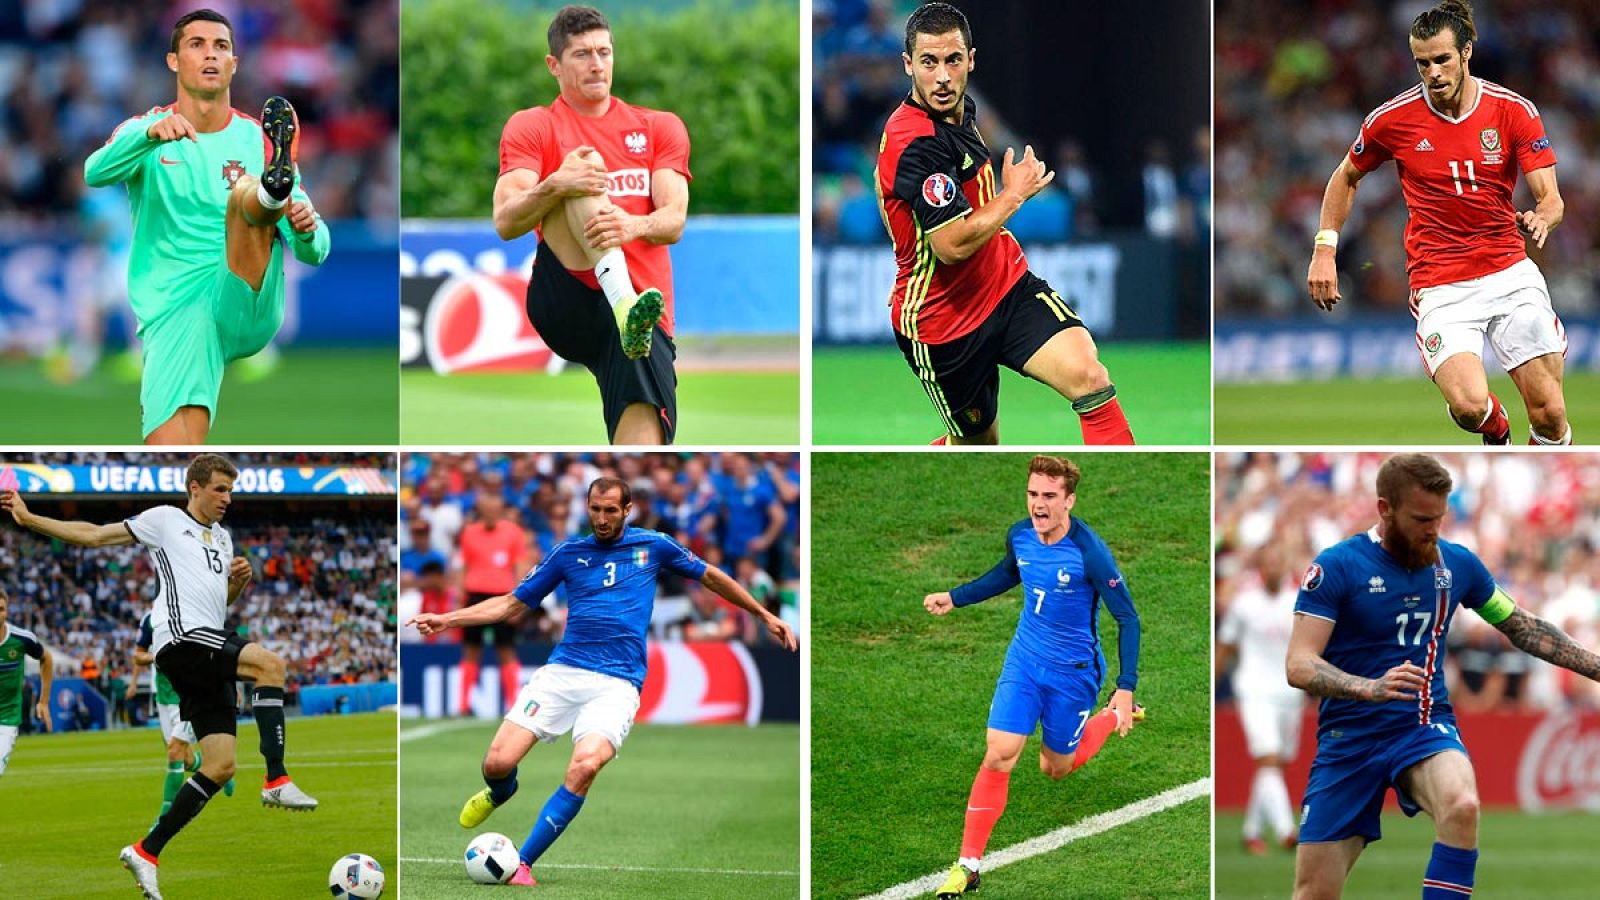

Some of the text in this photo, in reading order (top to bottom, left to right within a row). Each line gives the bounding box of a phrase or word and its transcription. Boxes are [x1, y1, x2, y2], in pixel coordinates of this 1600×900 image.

[608, 174, 645, 192] OTOS
[1448, 160, 1478, 195] 11
[90, 466, 156, 492] UEFA
[158, 468, 188, 492] EU
[202, 546, 223, 574] 13
[603, 562, 617, 588] 3
[1033, 587, 1046, 615] 7
[1395, 611, 1432, 646] 17
[1074, 709, 1090, 737] 7
